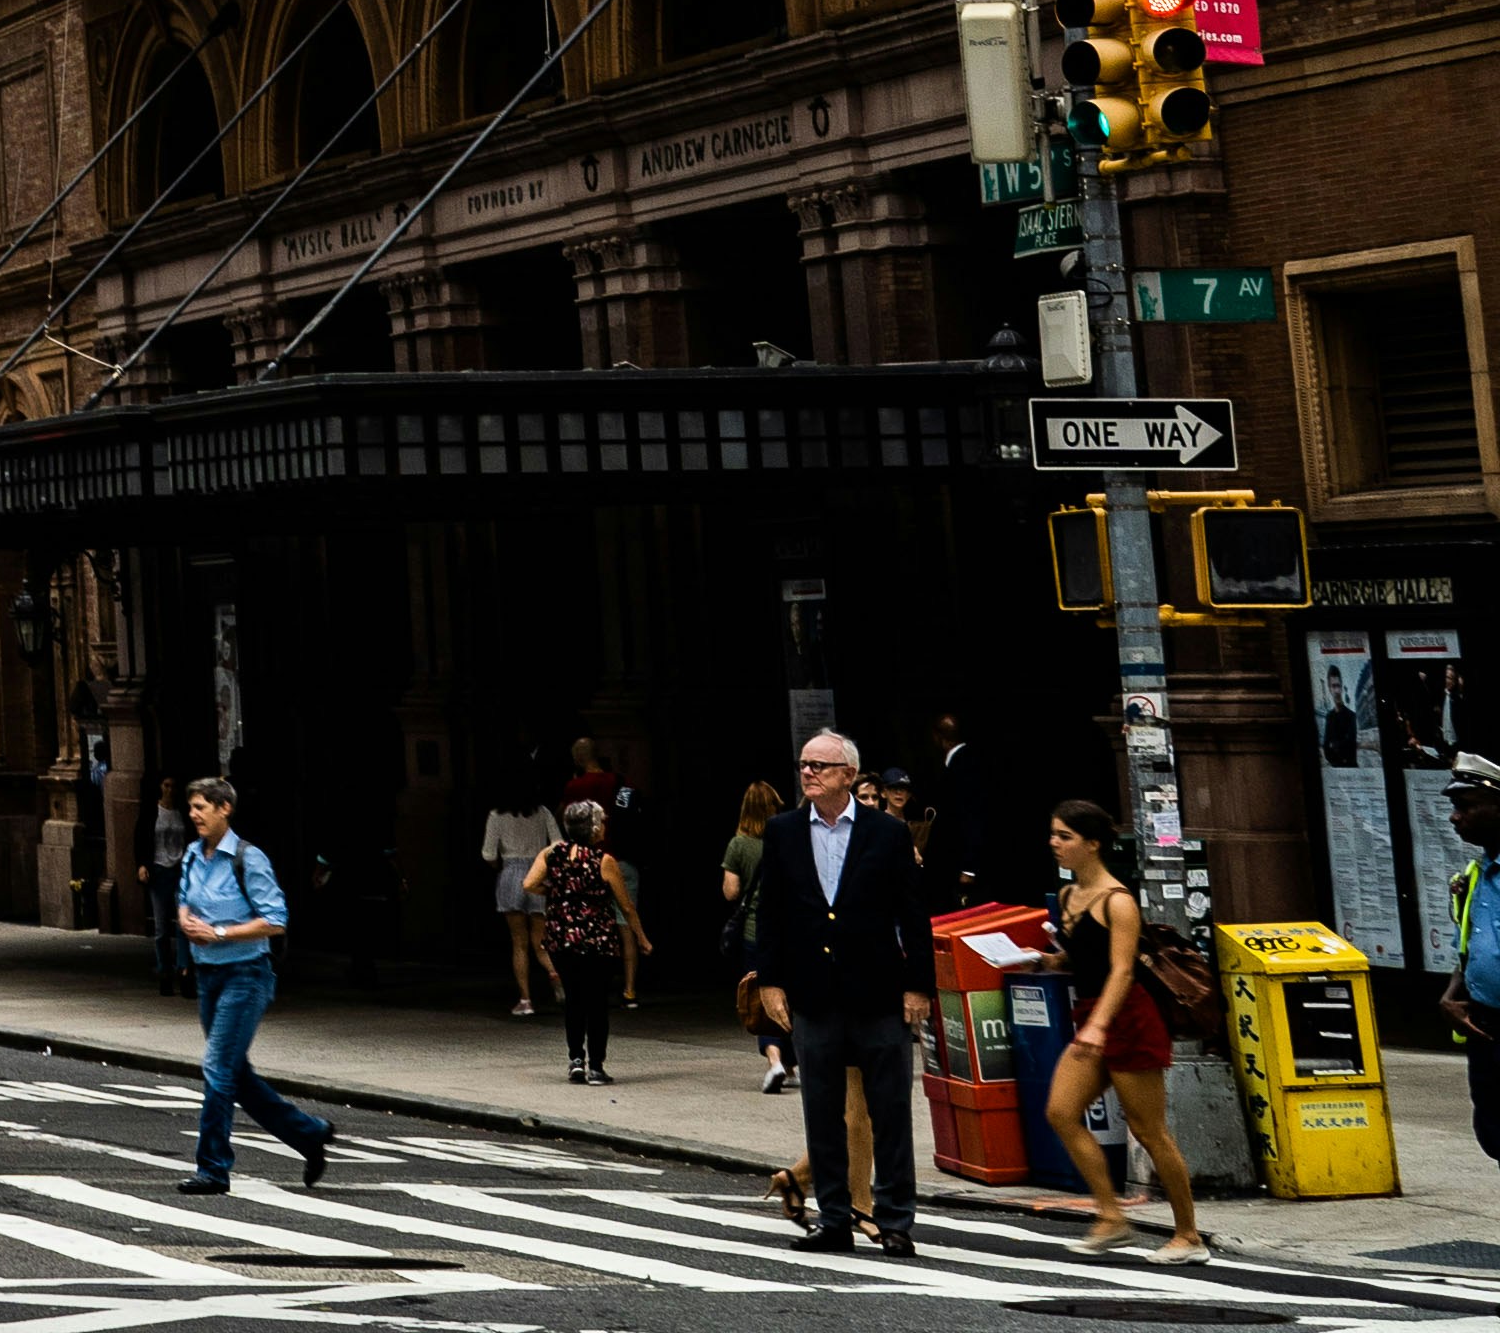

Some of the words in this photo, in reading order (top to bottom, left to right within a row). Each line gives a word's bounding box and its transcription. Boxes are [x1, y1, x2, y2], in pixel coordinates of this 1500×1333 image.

[1213, 2, 1241, 15] 1870
[640, 129, 706, 178] ANDREW
[710, 115, 793, 164] CARNEGIE
[528, 179, 545, 200] BY
[1004, 162, 1020, 194] W
[1018, 209, 1045, 238] ISAAC
[1047, 203, 1082, 232] STERN
[1034, 232, 1058, 247] PLACE
[1193, 278, 1218, 315] 7
[1239, 277, 1264, 297] AV
[1062, 421, 1120, 449] ONE
[1144, 421, 1203, 449] WAY
[1312, 580, 1388, 606] CARNEGIE
[1395, 578, 1440, 604] HALL
